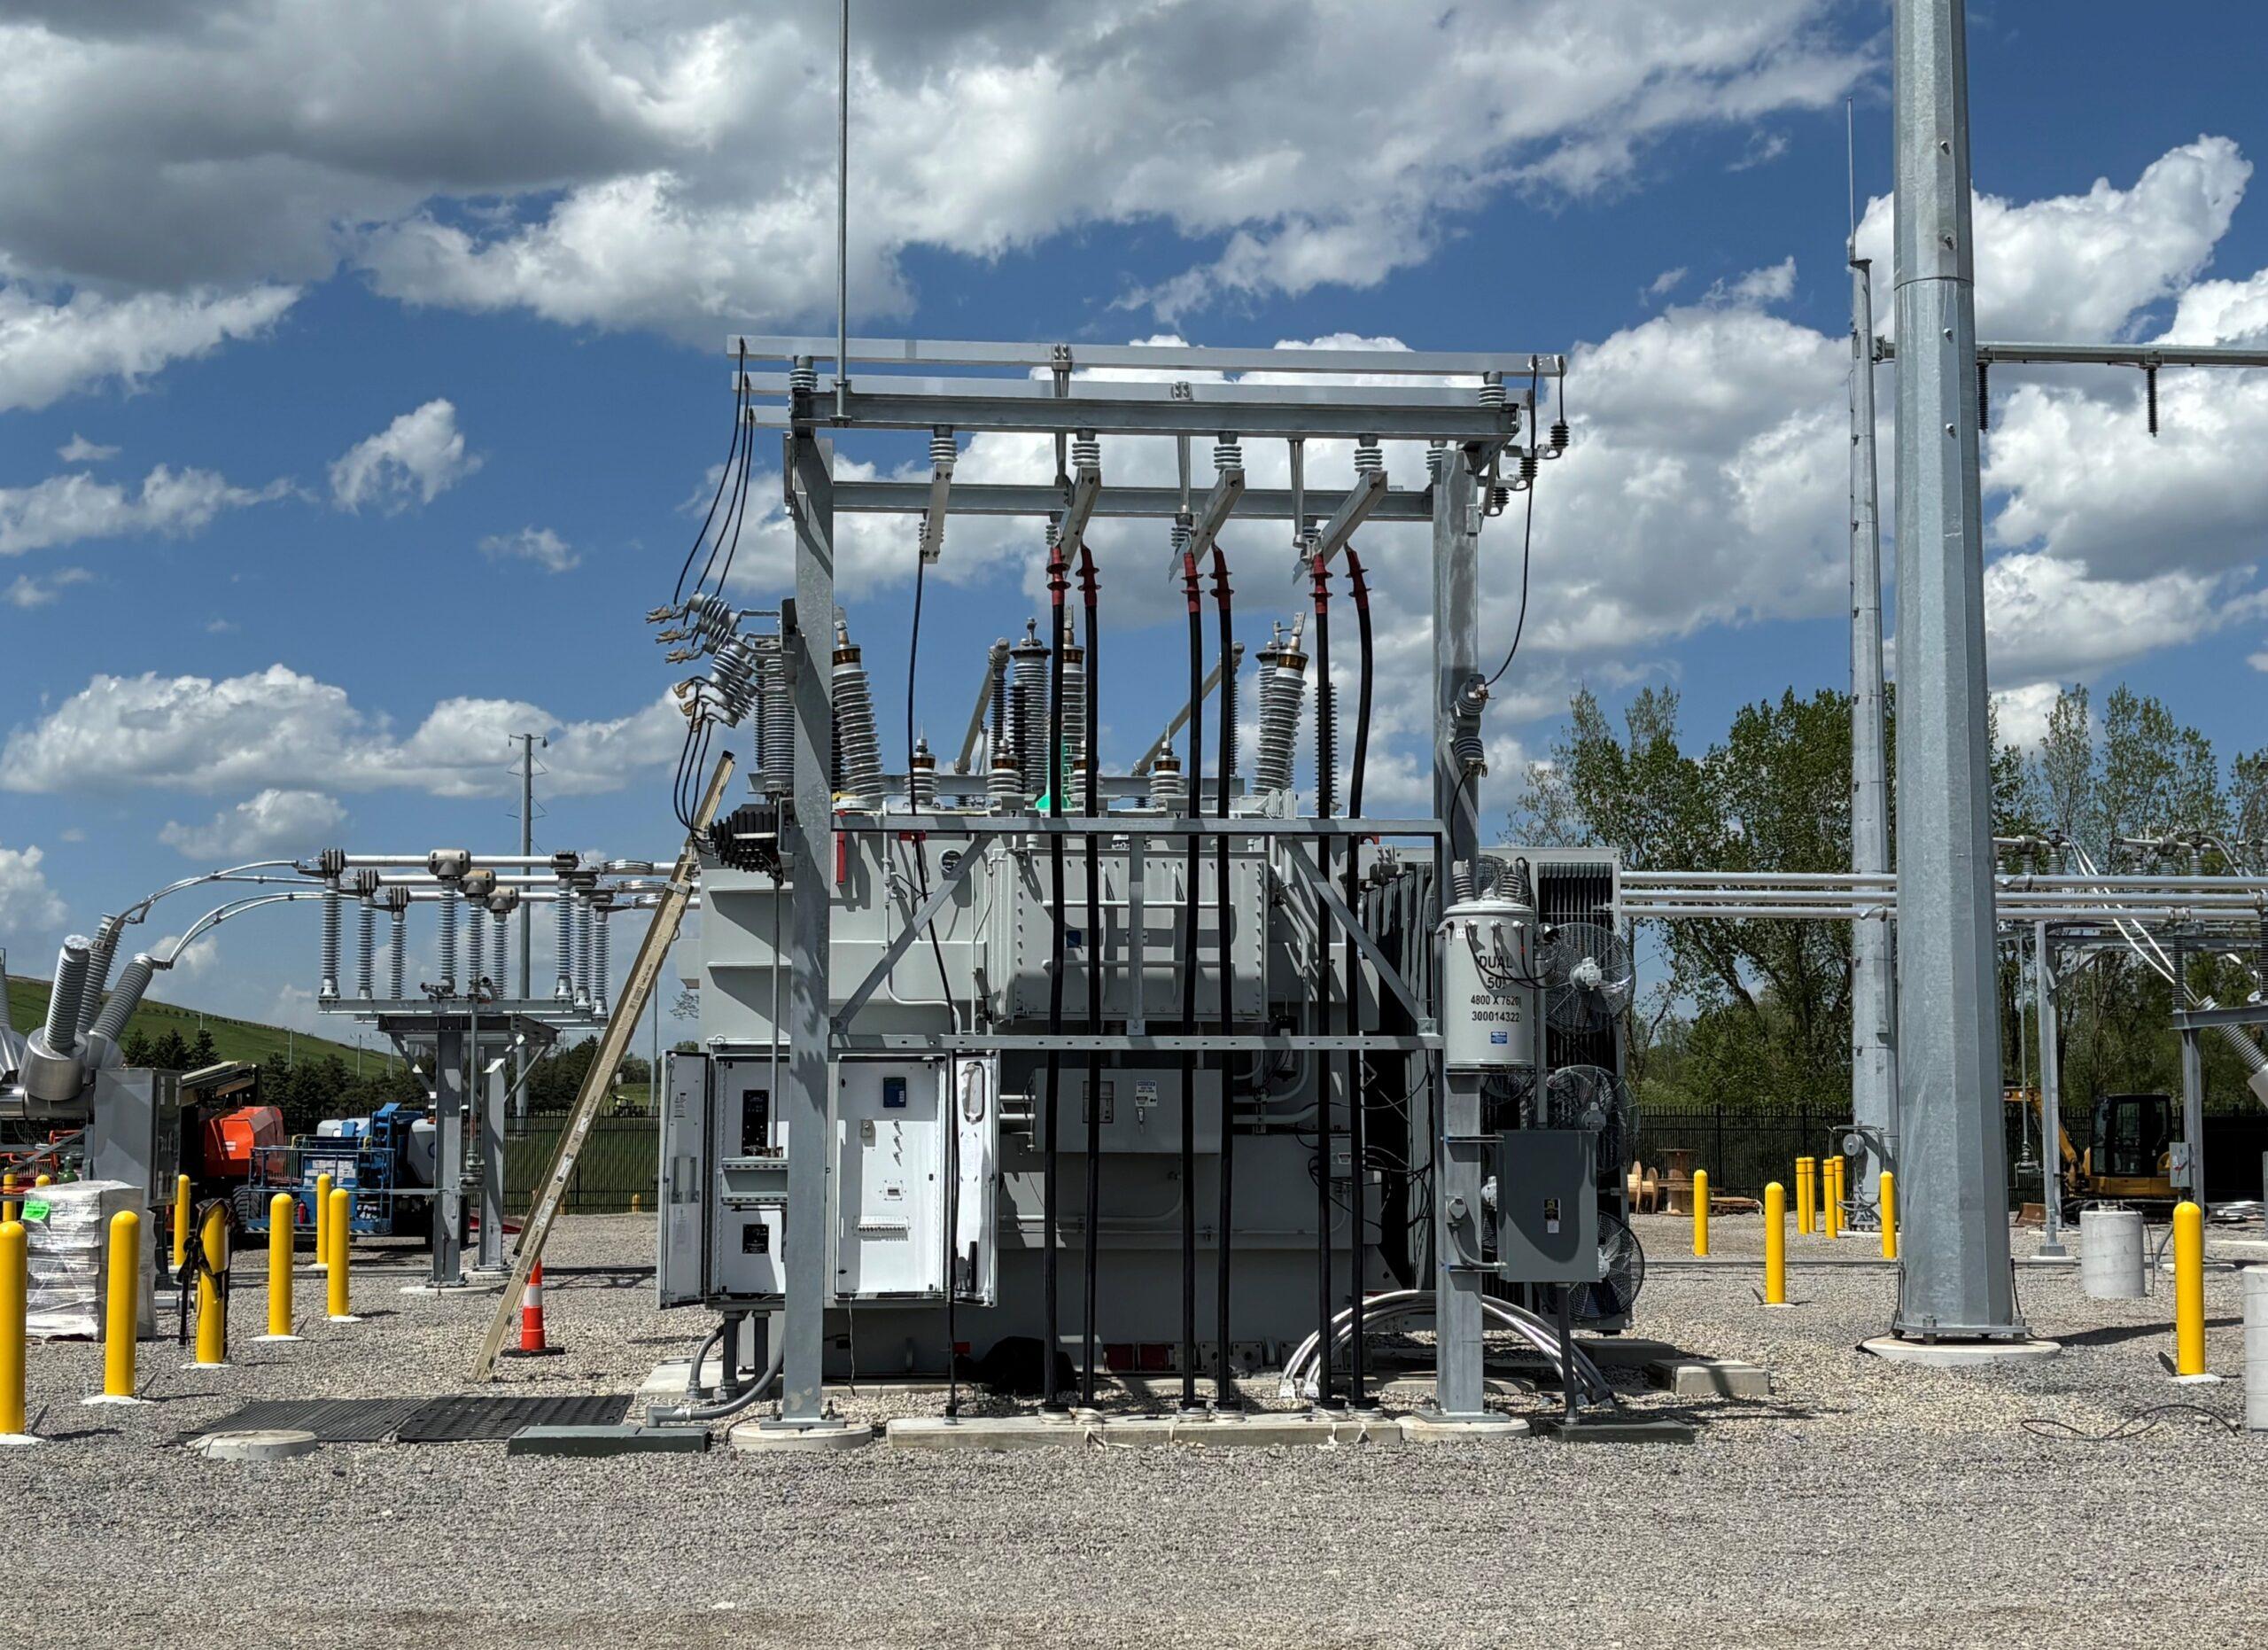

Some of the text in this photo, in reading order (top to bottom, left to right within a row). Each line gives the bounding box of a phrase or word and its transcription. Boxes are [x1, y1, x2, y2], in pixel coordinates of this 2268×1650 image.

[1479, 955, 1513, 969] DUAL
[1471, 994, 1490, 1005] 4800
[1493, 995, 1499, 1005] X
